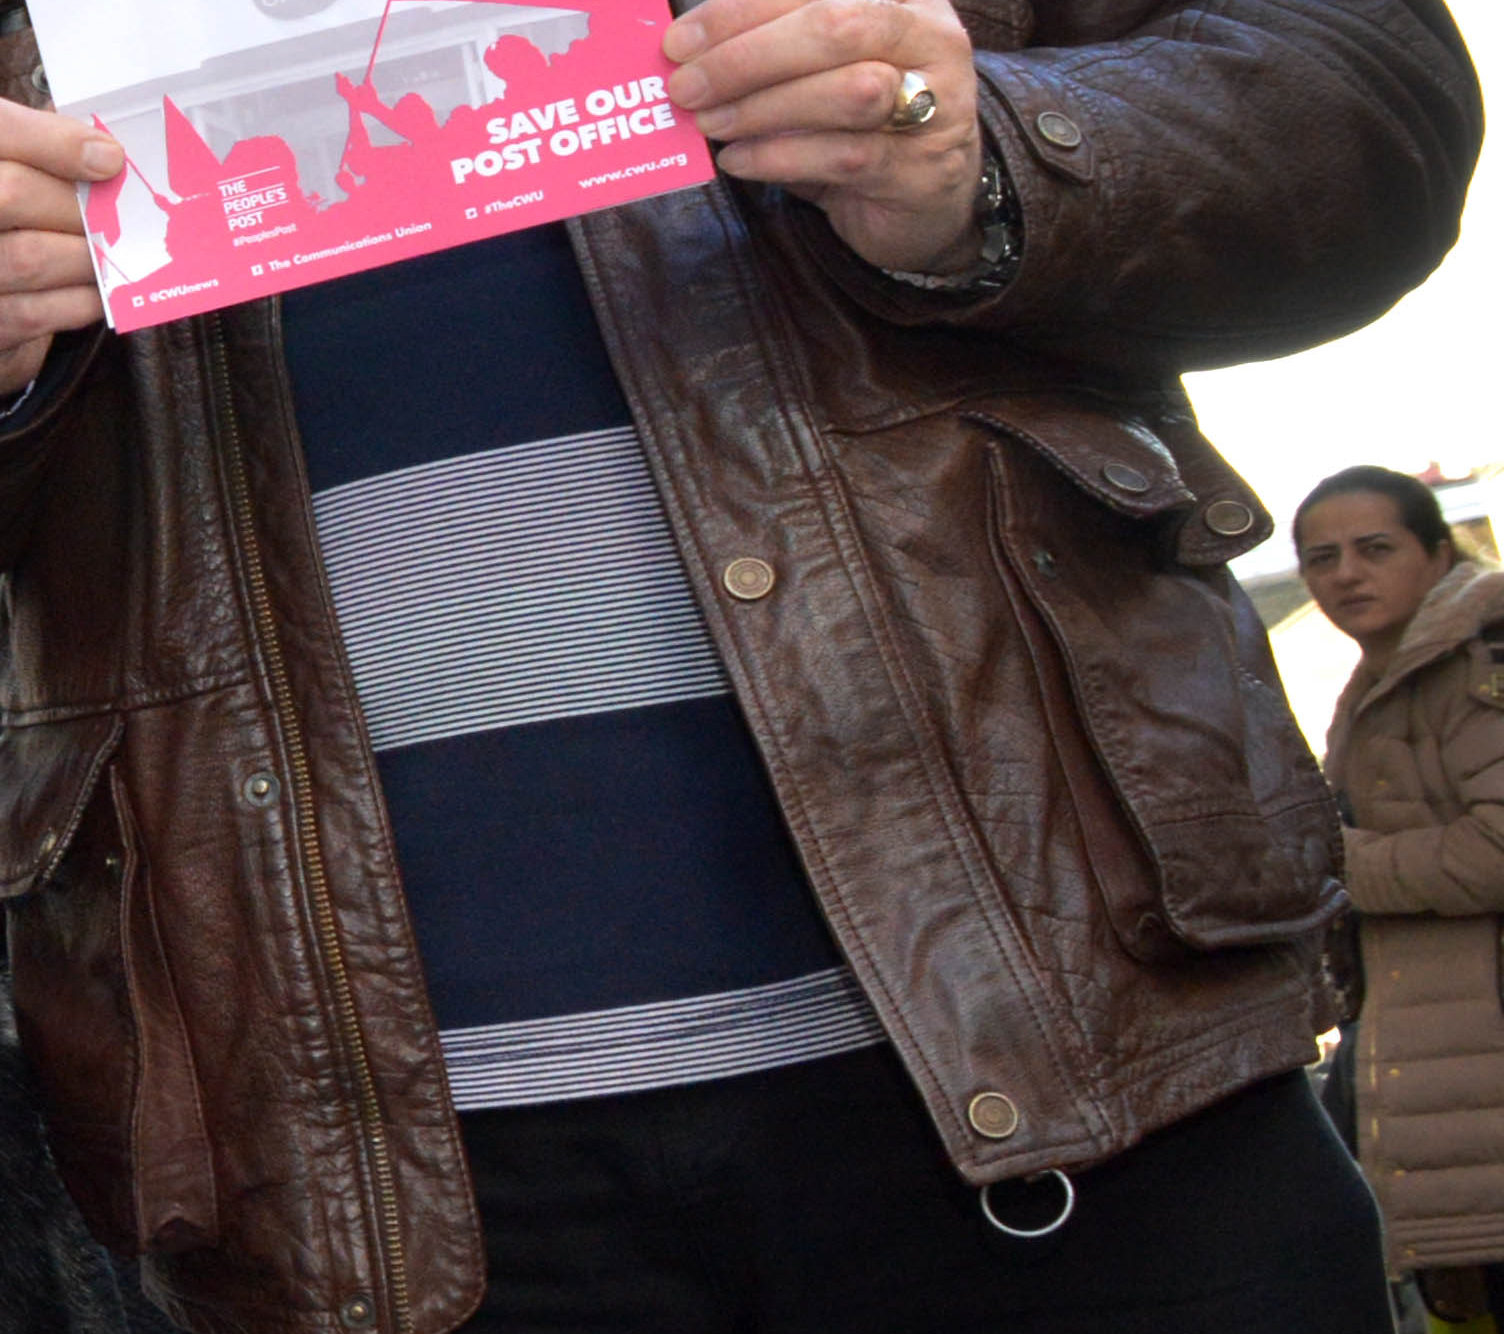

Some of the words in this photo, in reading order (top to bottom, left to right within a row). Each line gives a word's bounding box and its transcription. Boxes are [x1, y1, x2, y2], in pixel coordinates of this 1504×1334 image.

[486, 98, 580, 145] SAVE
[585, 75, 669, 117] OUR
[450, 138, 542, 186] POST
[549, 103, 676, 157] OFFICE
[578, 152, 688, 189] www.cwu.org
[218, 179, 248, 199] THE
[223, 185, 288, 215] PEOPLE'S
[483, 189, 545, 216] #TheCWU
[227, 210, 265, 232] POST
[268, 257, 291, 273] The
[293, 231, 394, 266] Communications
[394, 220, 433, 239] Union
[148, 277, 219, 303] @CWUnews
